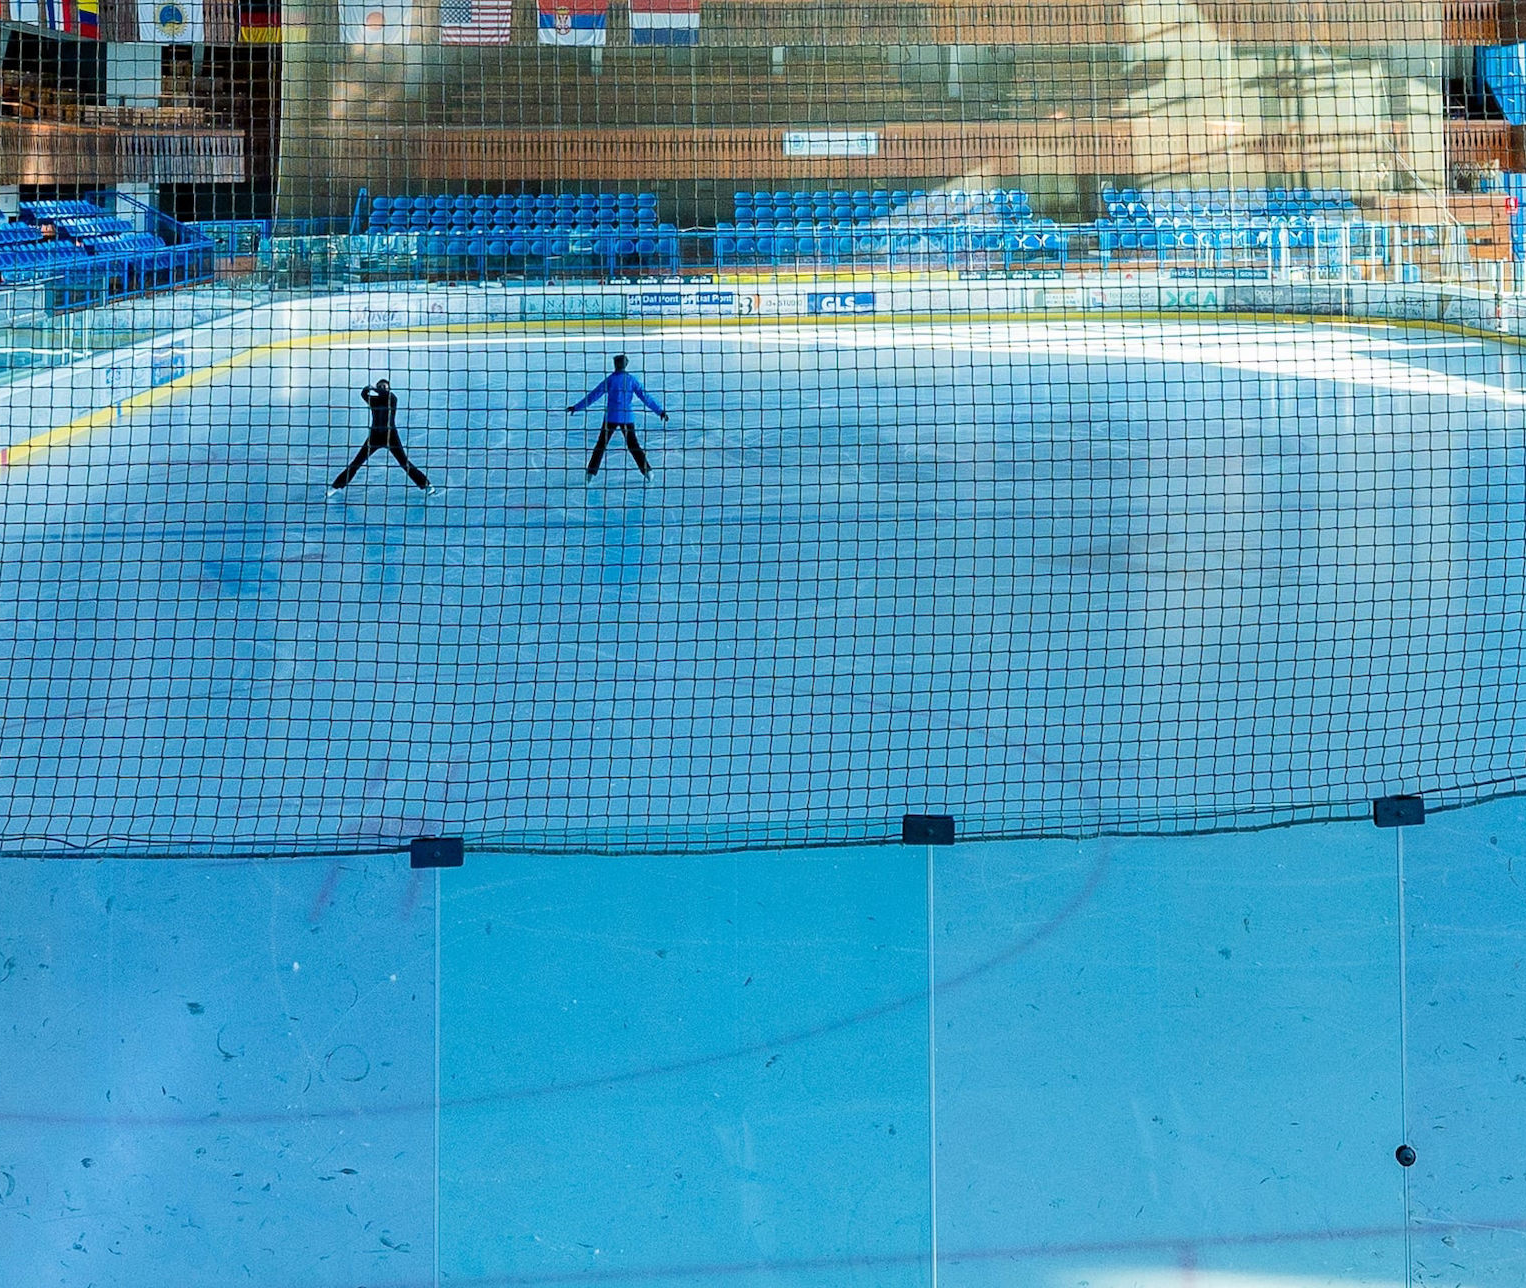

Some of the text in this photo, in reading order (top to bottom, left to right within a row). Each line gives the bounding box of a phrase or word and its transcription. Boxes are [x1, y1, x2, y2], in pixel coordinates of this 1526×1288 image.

[642, 294, 657, 303] Dal
[712, 294, 732, 303] Pont
[821, 296, 855, 312] GLS
